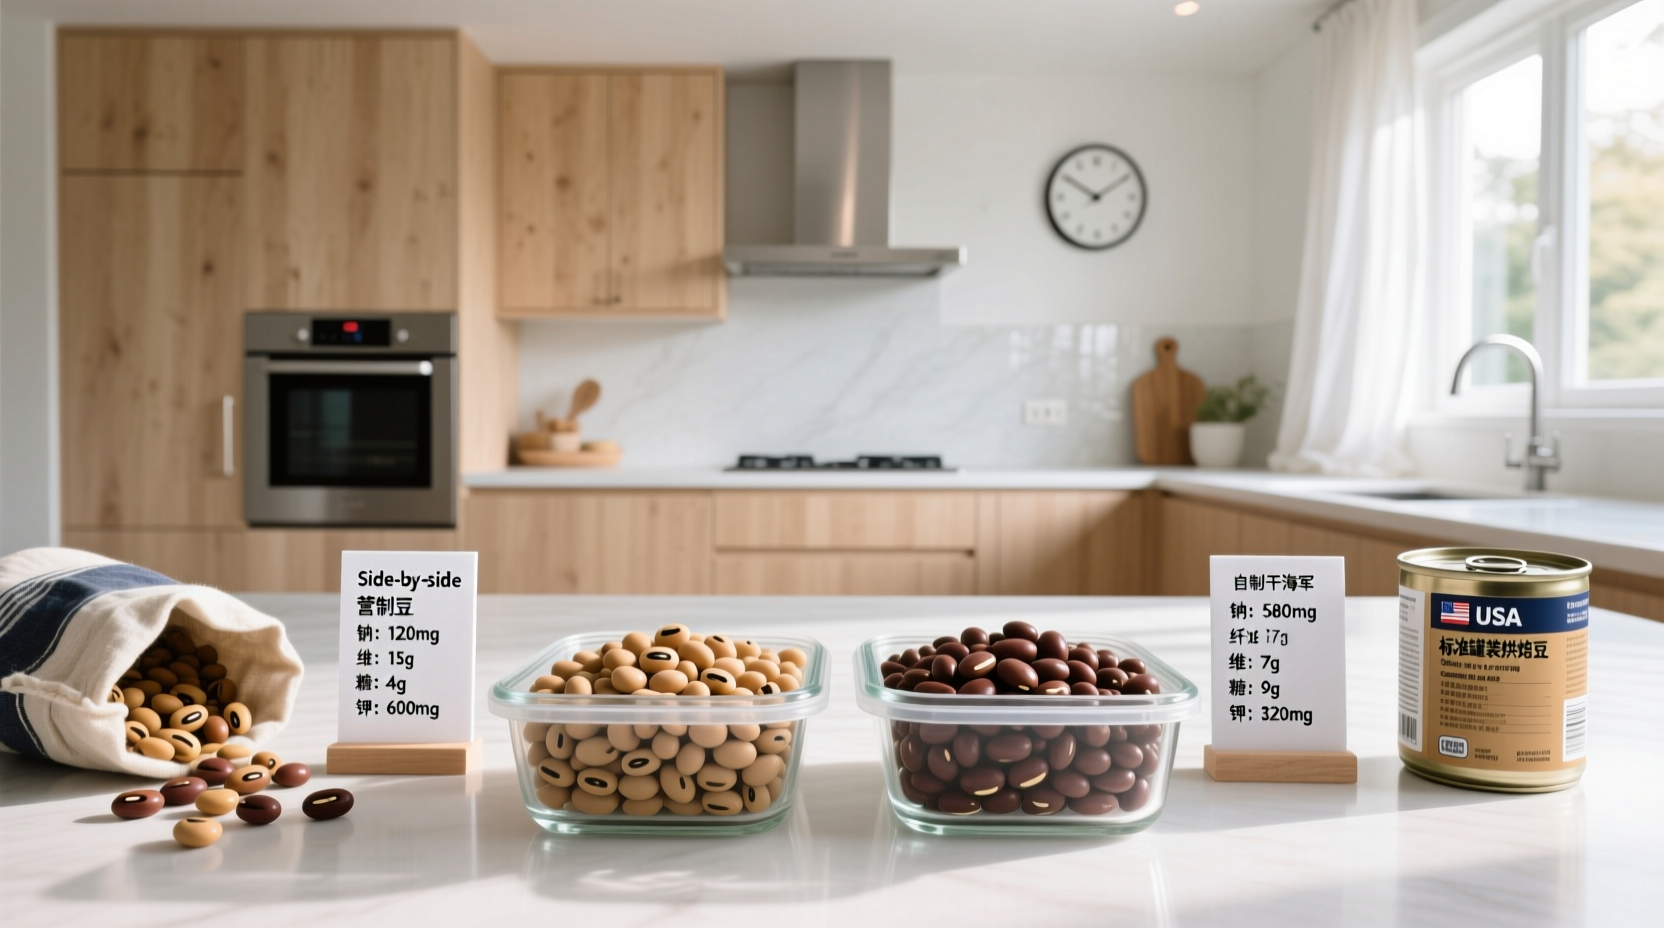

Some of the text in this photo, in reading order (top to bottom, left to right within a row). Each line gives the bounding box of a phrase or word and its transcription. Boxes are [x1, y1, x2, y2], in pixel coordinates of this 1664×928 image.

[358, 570, 462, 592] Side-by-side
[1234, 573, 1315, 592] 自制干海军
[1262, 603, 1317, 623] 580mg
[1476, 606, 1523, 627] USA
[388, 625, 440, 645] 120mg
[388, 651, 415, 670] 15g
[1260, 655, 1280, 674] 7g
[385, 675, 407, 695] 4g
[1261, 680, 1281, 700] 9g
[386, 700, 440, 720] 600mg
[1262, 706, 1313, 727] 320mg
